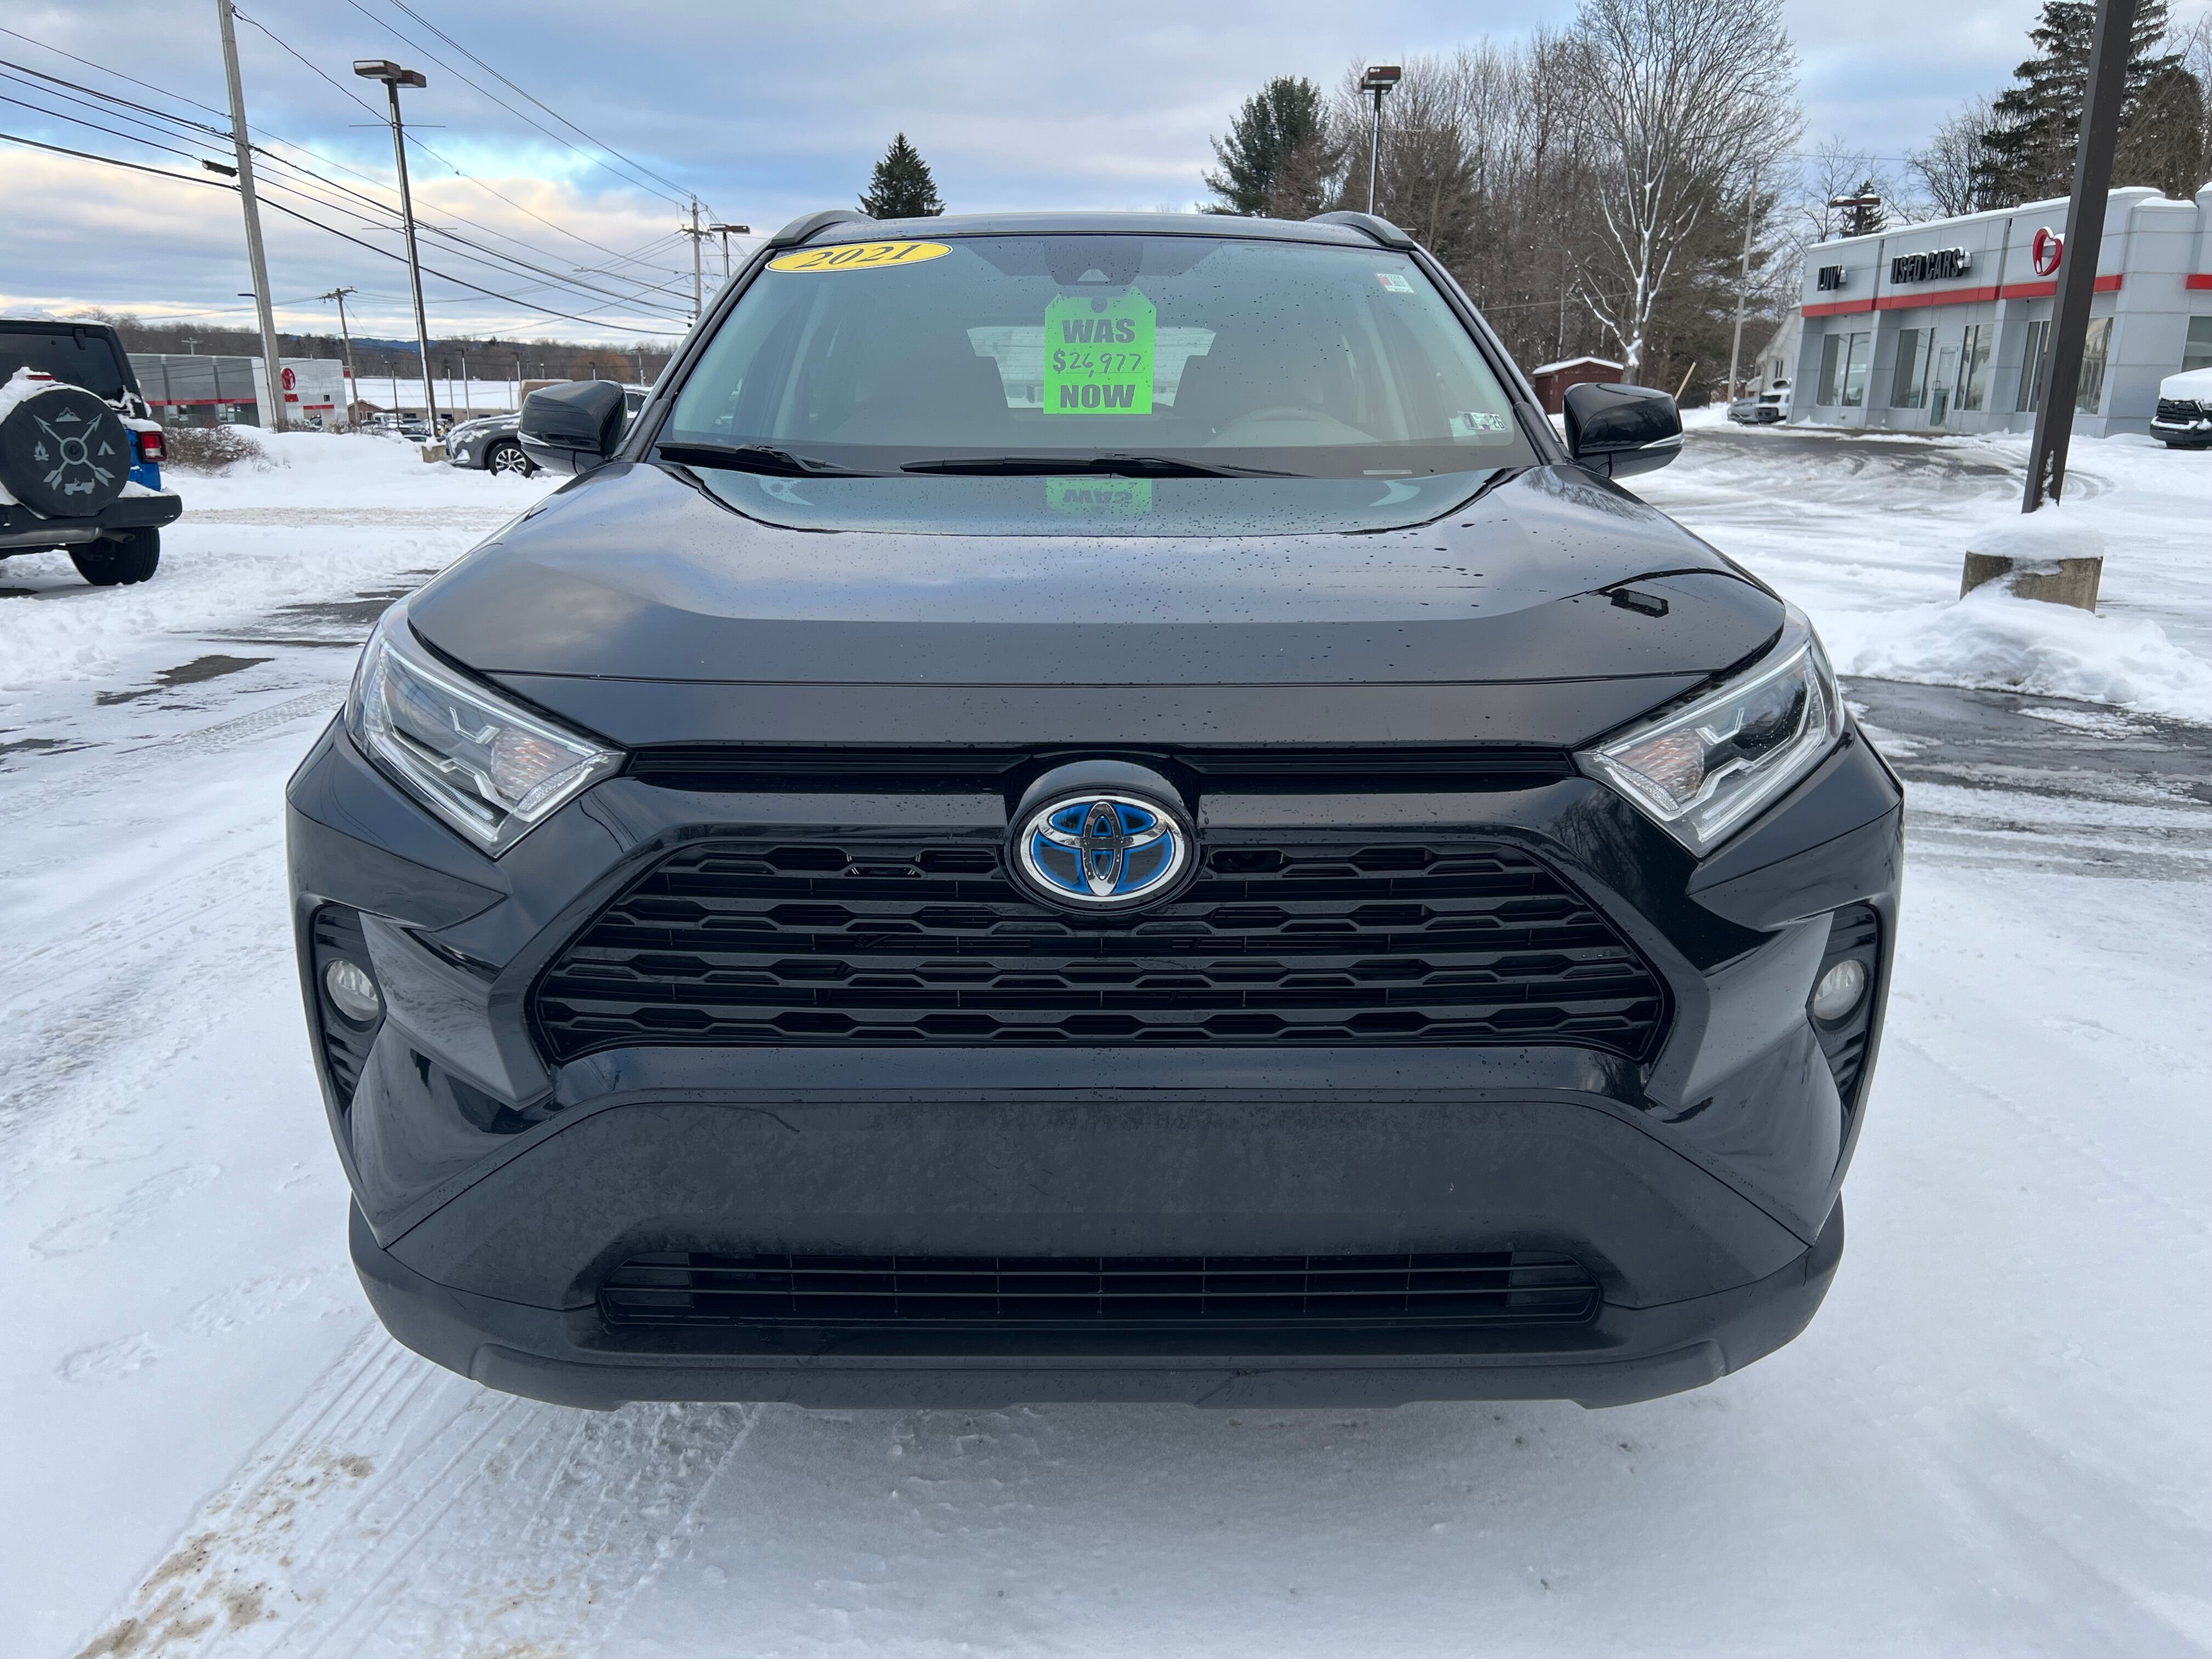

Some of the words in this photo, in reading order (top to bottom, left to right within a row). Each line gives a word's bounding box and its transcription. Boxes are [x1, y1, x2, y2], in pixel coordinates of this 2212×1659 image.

[794, 244, 923, 268] 2021
[1891, 255, 1925, 284] USED
[1926, 248, 1961, 280] CARS
[1062, 318, 1136, 343] WAS
[1053, 348, 1142, 378] $26,977
[1060, 384, 1136, 408] NOW
[1489, 415, 1505, 428] 26
